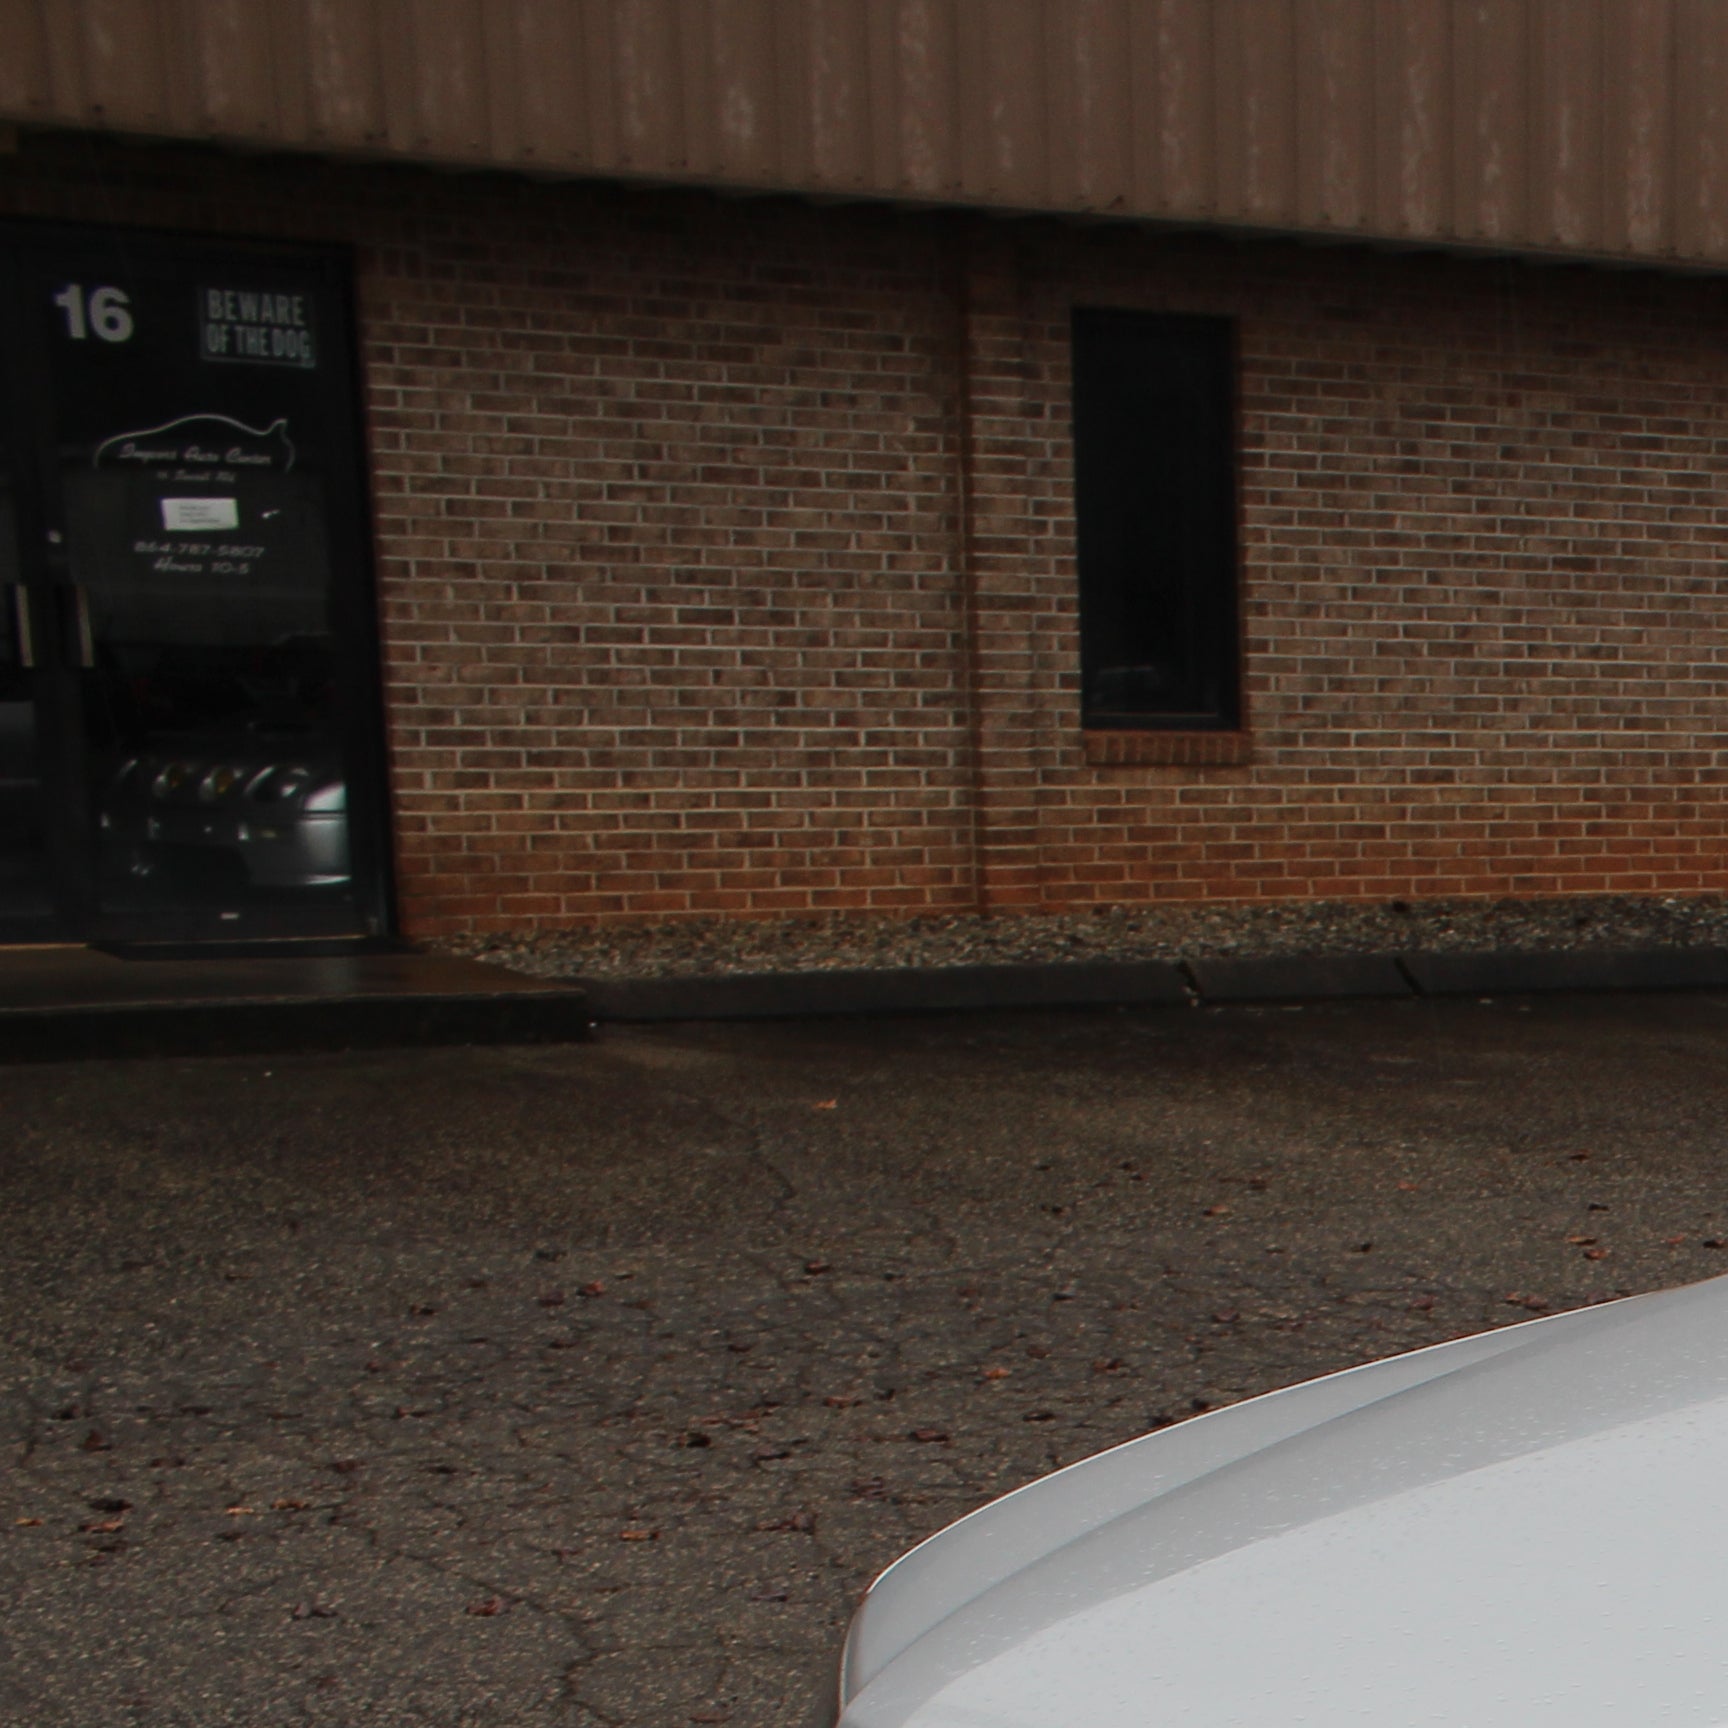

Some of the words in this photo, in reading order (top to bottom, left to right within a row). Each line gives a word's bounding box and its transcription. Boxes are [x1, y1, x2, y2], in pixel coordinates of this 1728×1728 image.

[54, 284, 134, 343] 16
[207, 288, 305, 326] BEWARE
[206, 323, 229, 354] OF
[234, 325, 270, 357] THE
[271, 327, 312, 360] DOG
